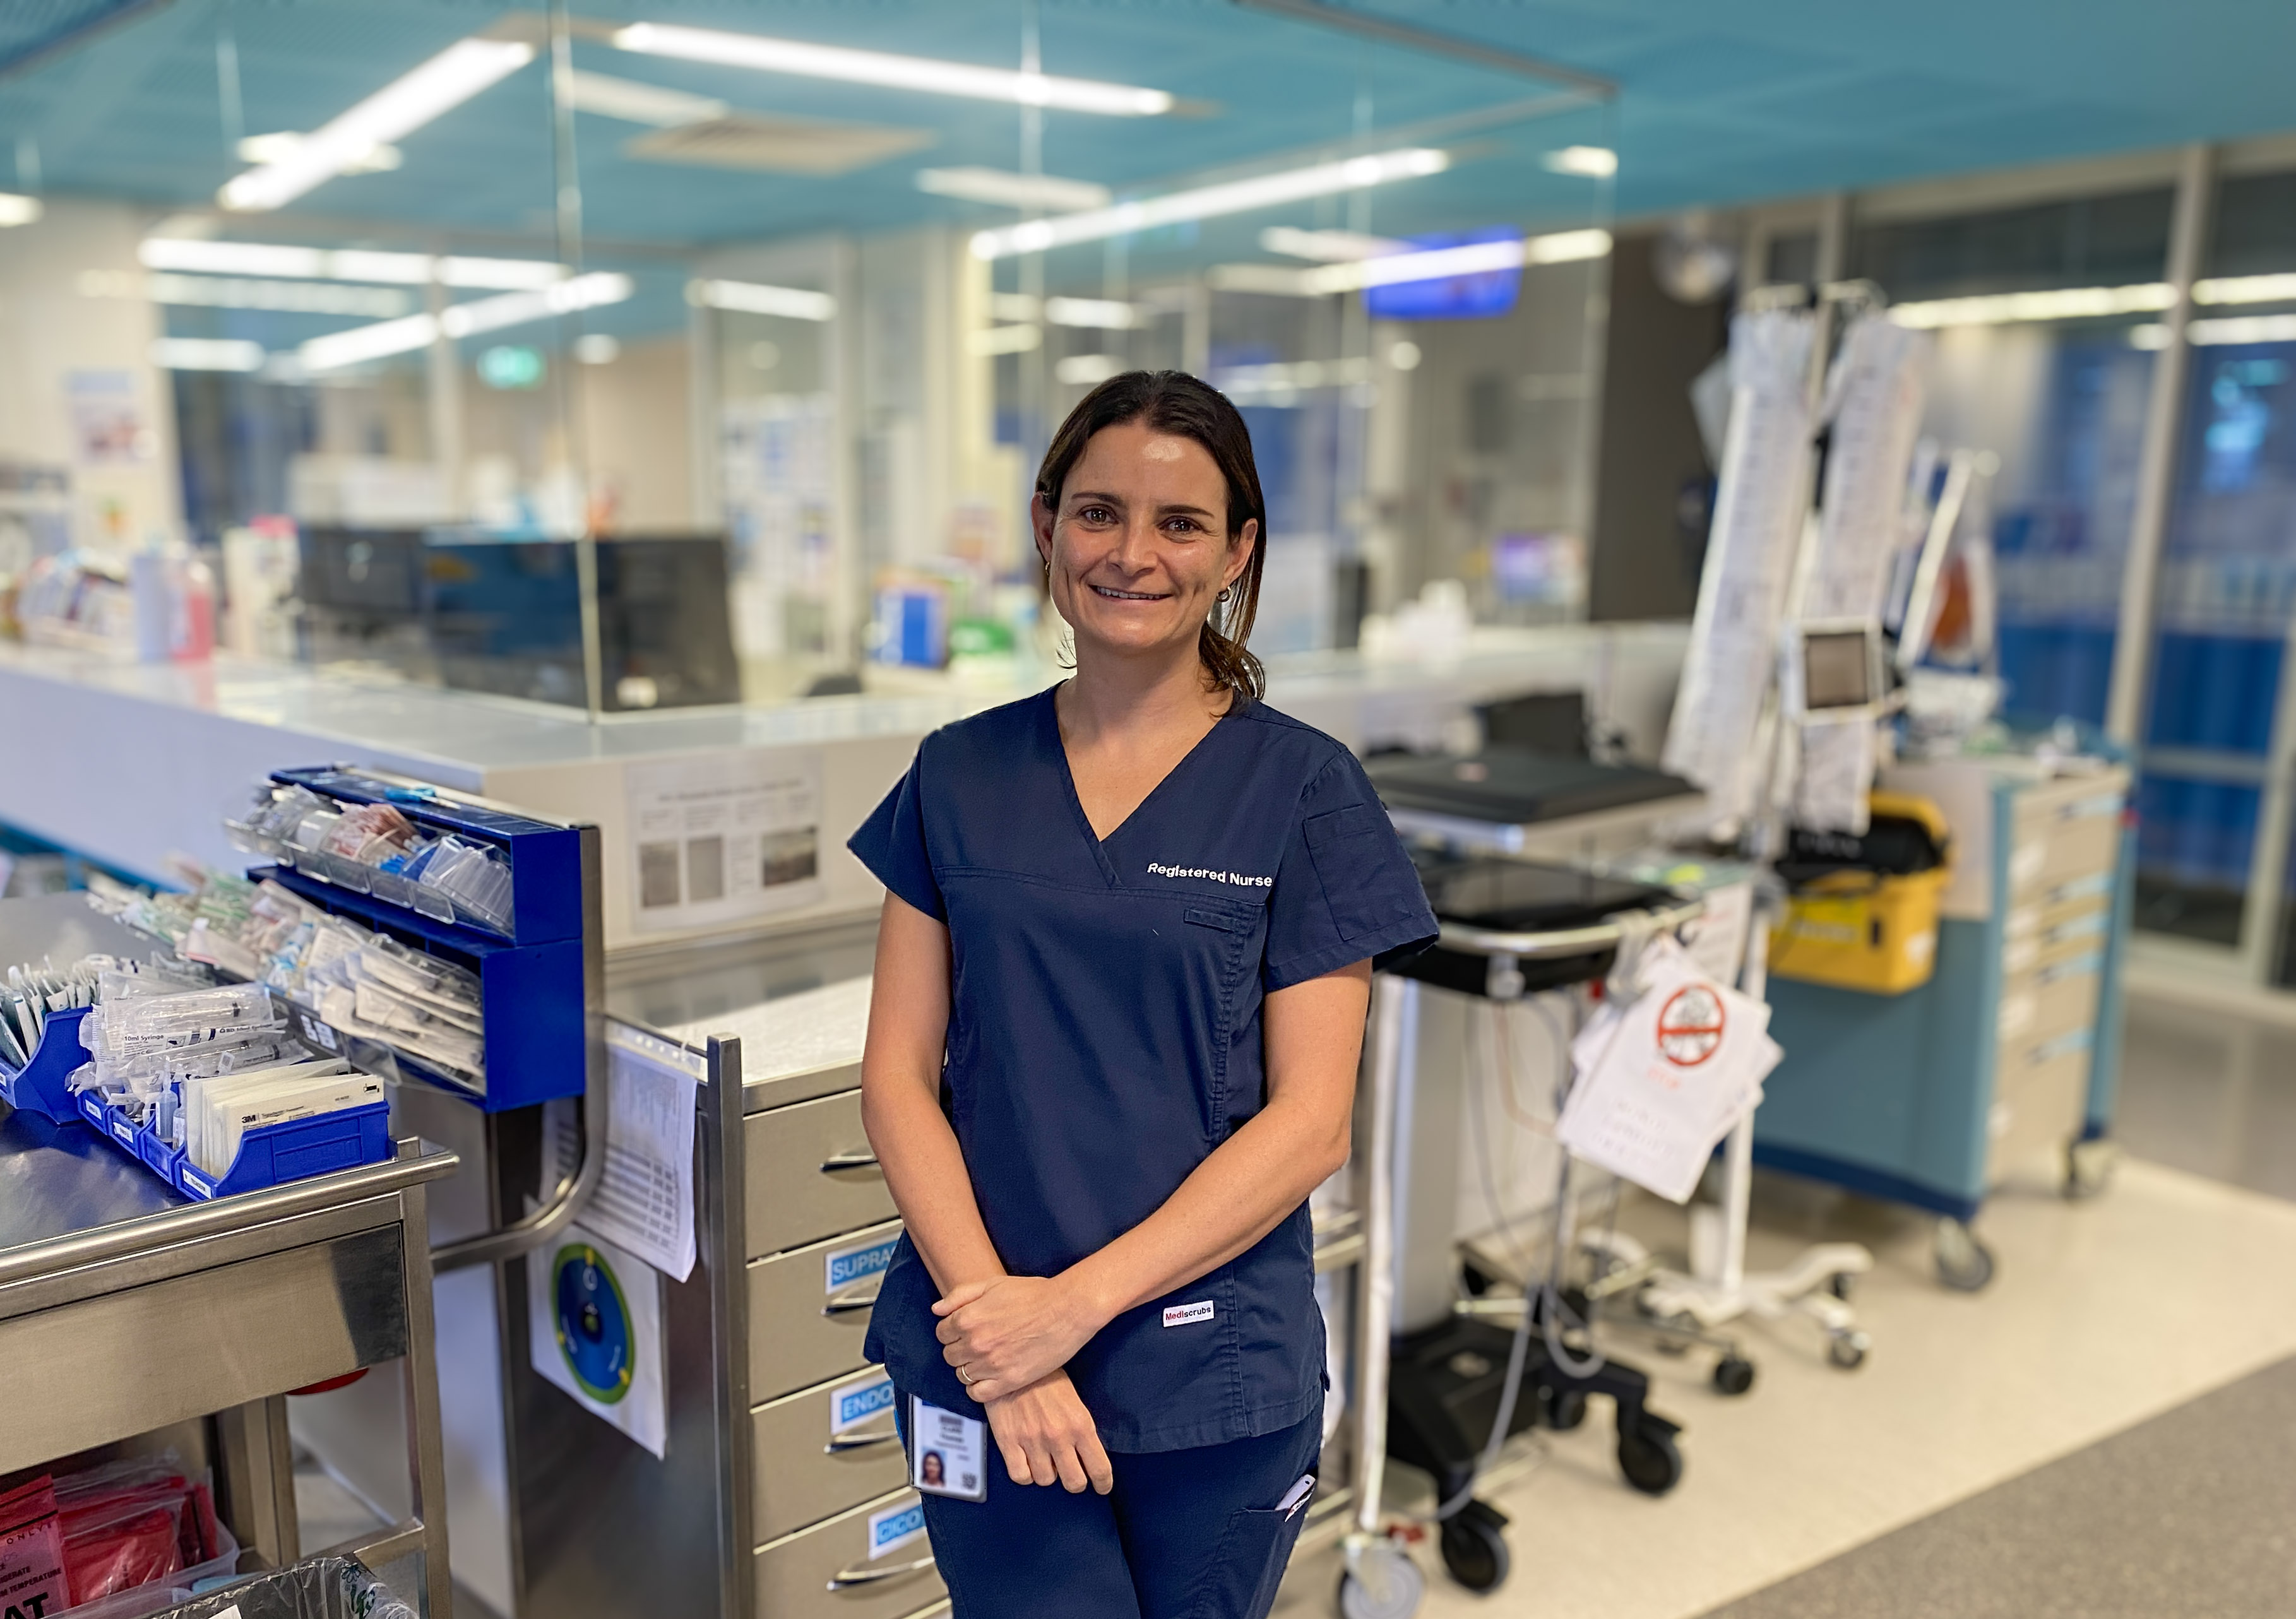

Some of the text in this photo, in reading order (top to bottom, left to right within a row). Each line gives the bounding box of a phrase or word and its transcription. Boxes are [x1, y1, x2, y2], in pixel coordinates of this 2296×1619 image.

[1147, 863, 1273, 887] Registered Nurse
[242, 1115, 256, 1124] 3M
[833, 1246, 896, 1281] SUPRA
[1165, 1307, 1211, 1320] Mediscrubs
[9, 1567, 62, 1593] TEMPERATURE
